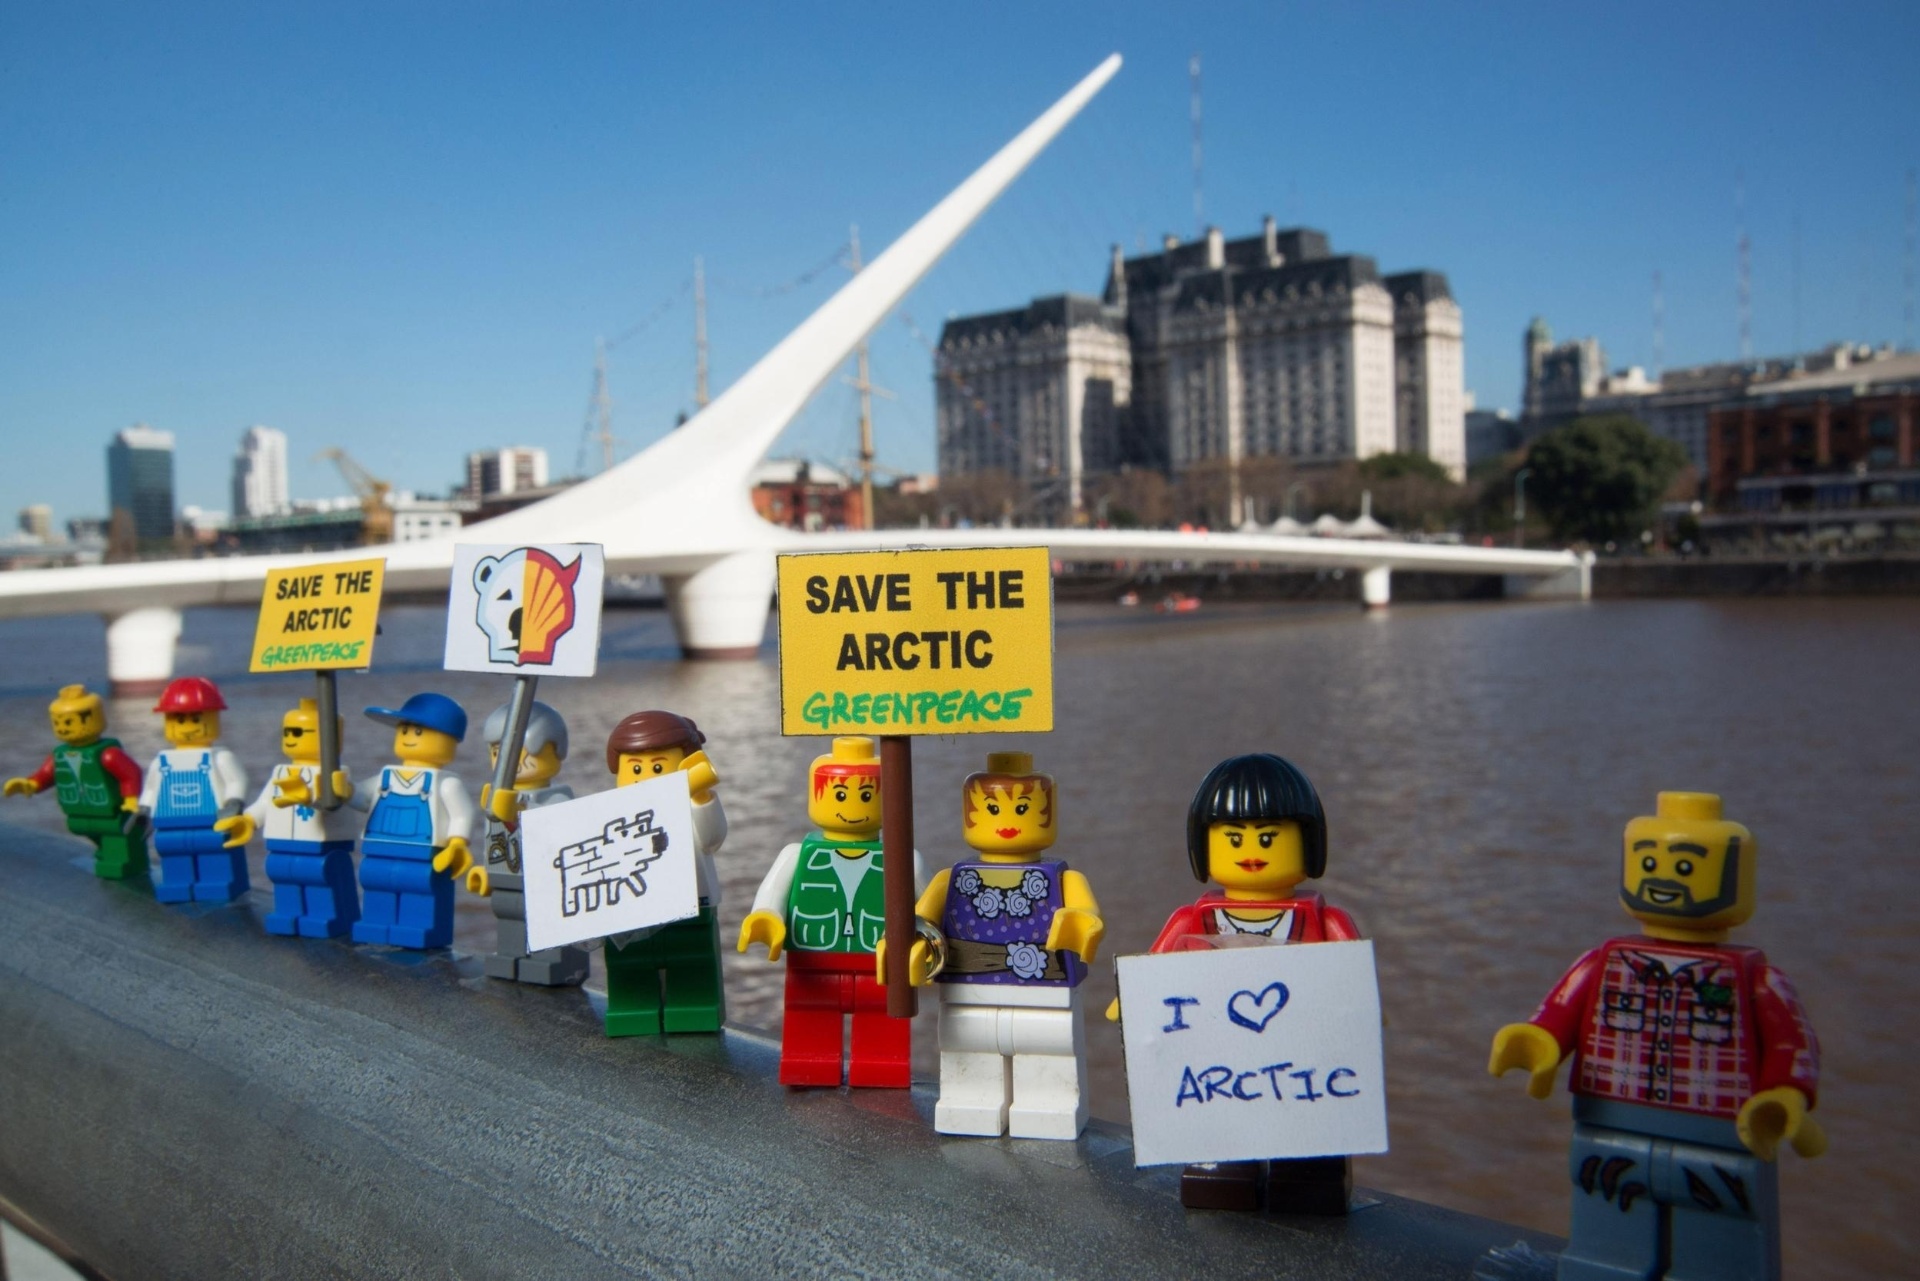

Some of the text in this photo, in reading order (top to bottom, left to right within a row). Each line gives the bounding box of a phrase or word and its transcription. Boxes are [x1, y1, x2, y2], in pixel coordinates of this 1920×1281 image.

[276, 570, 373, 600] SAVE THE
[806, 570, 1024, 614] SAVE THE
[282, 606, 353, 633] ARCTIC
[261, 640, 365, 667] GREENPEACE
[836, 630, 993, 671] ARCTIC
[802, 688, 1033, 729] GREENPEACE
[1162, 997, 1200, 1033] I
[1176, 1062, 1360, 1107] ARCTIC
